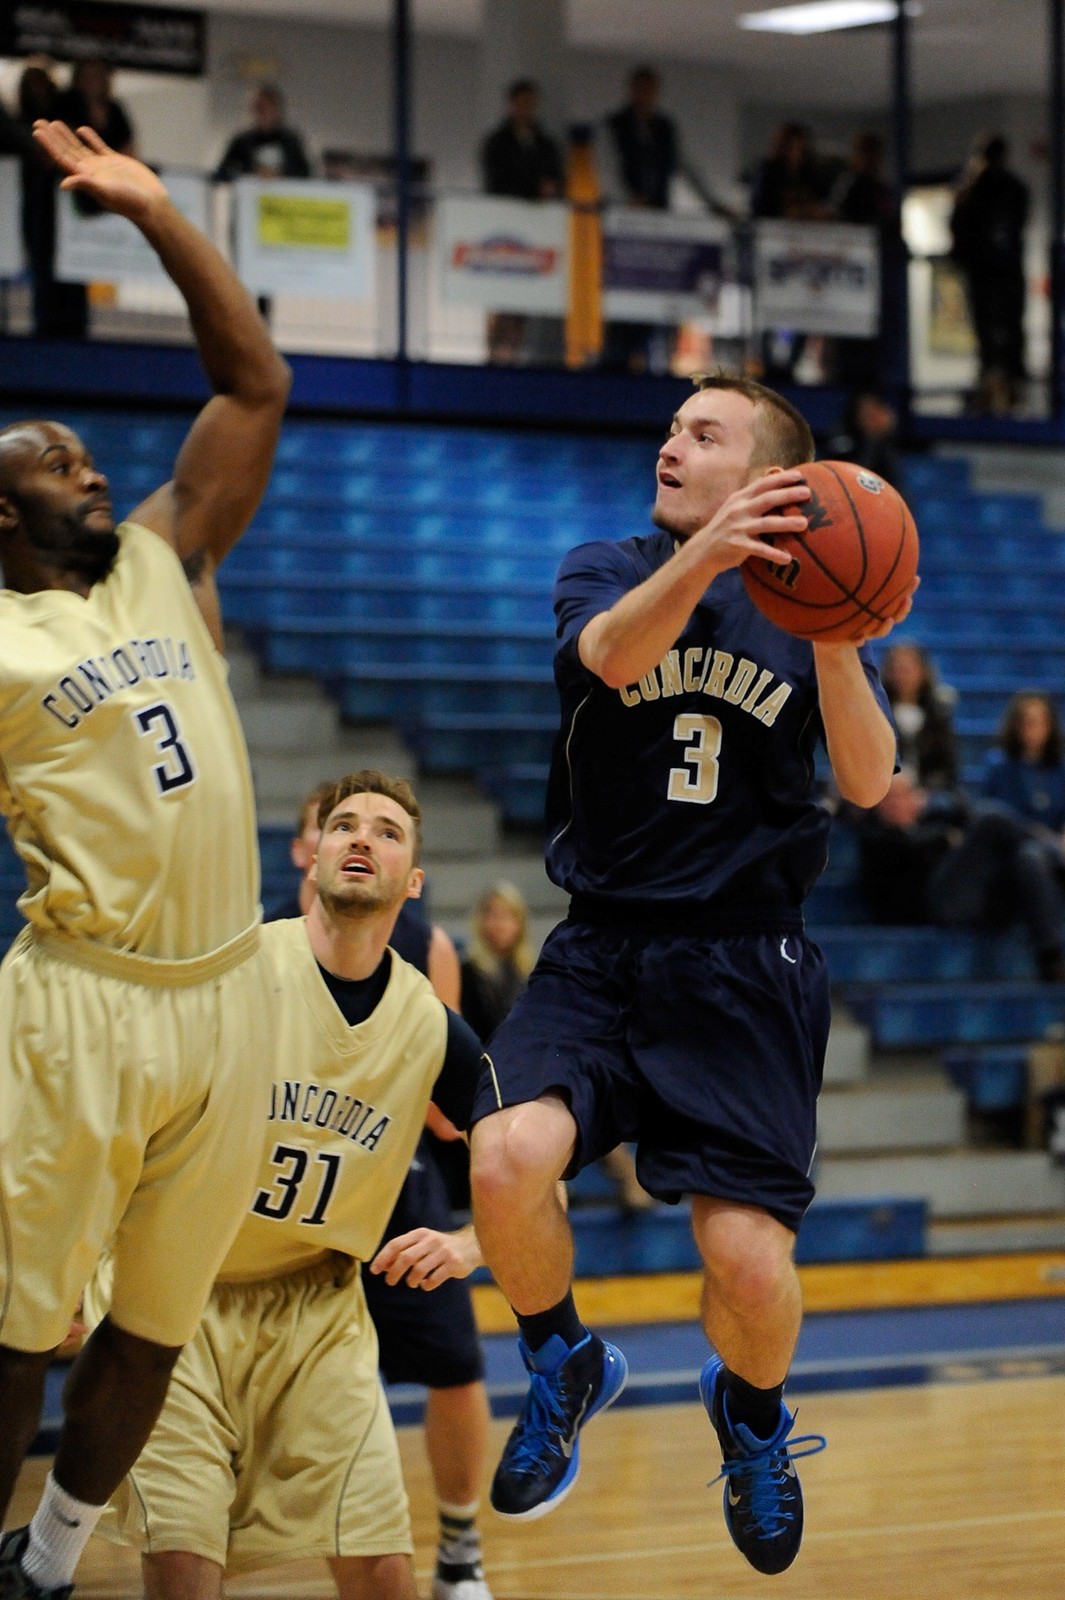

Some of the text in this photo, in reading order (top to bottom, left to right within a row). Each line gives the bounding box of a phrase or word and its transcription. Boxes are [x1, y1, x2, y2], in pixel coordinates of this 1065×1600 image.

[132, 701, 197, 797] 3
[667, 713, 722, 804] 3
[249, 1142, 344, 1227] 31
